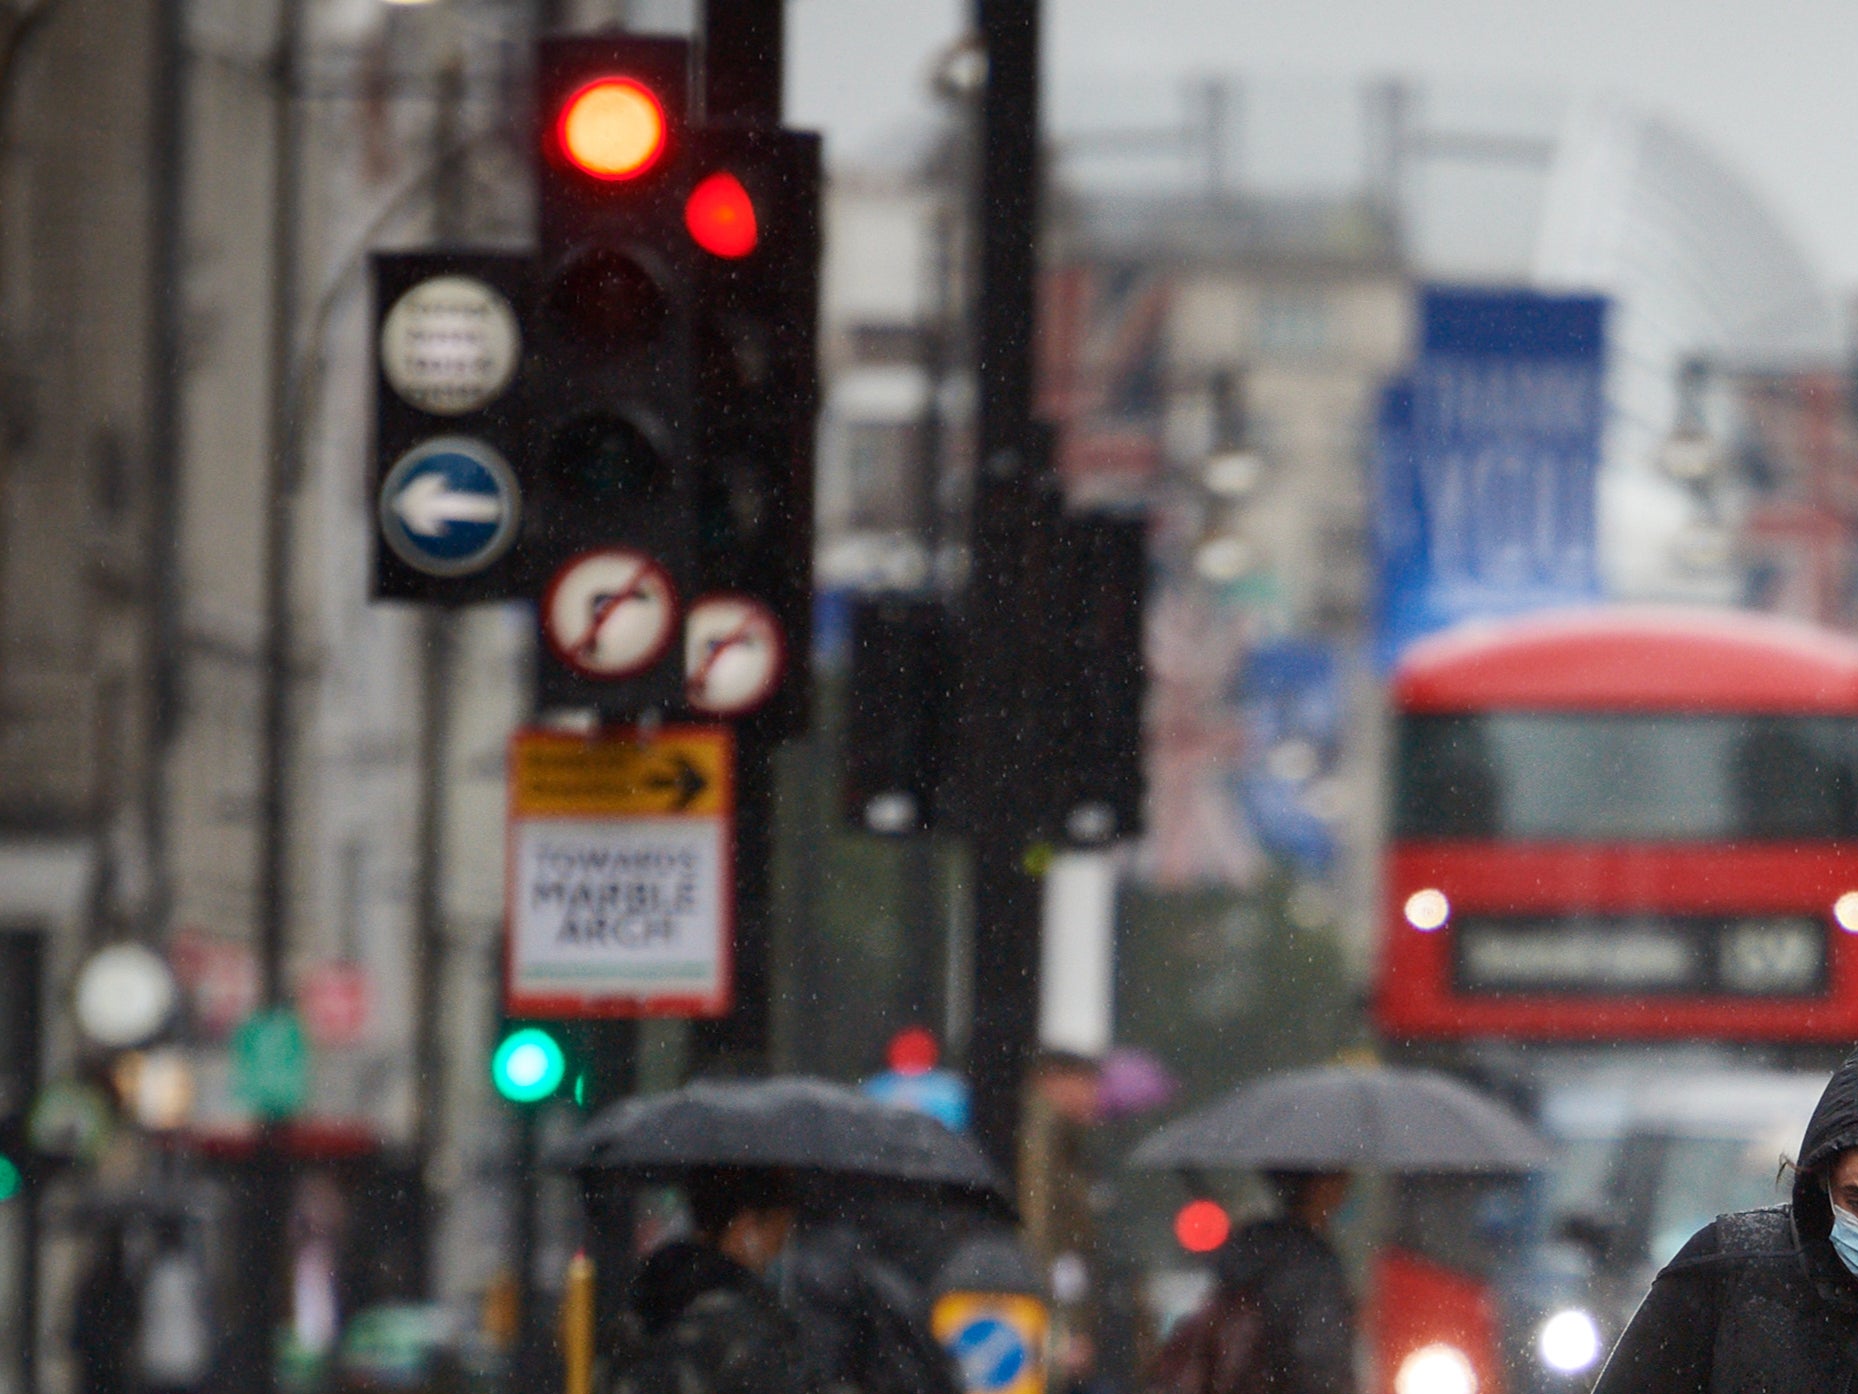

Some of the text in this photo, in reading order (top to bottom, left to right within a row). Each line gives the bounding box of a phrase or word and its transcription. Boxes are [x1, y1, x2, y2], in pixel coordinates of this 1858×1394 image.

[533, 845, 700, 875] TOWARDS
[531, 880, 700, 914] MARBLE
[556, 914, 677, 946] ARCH
